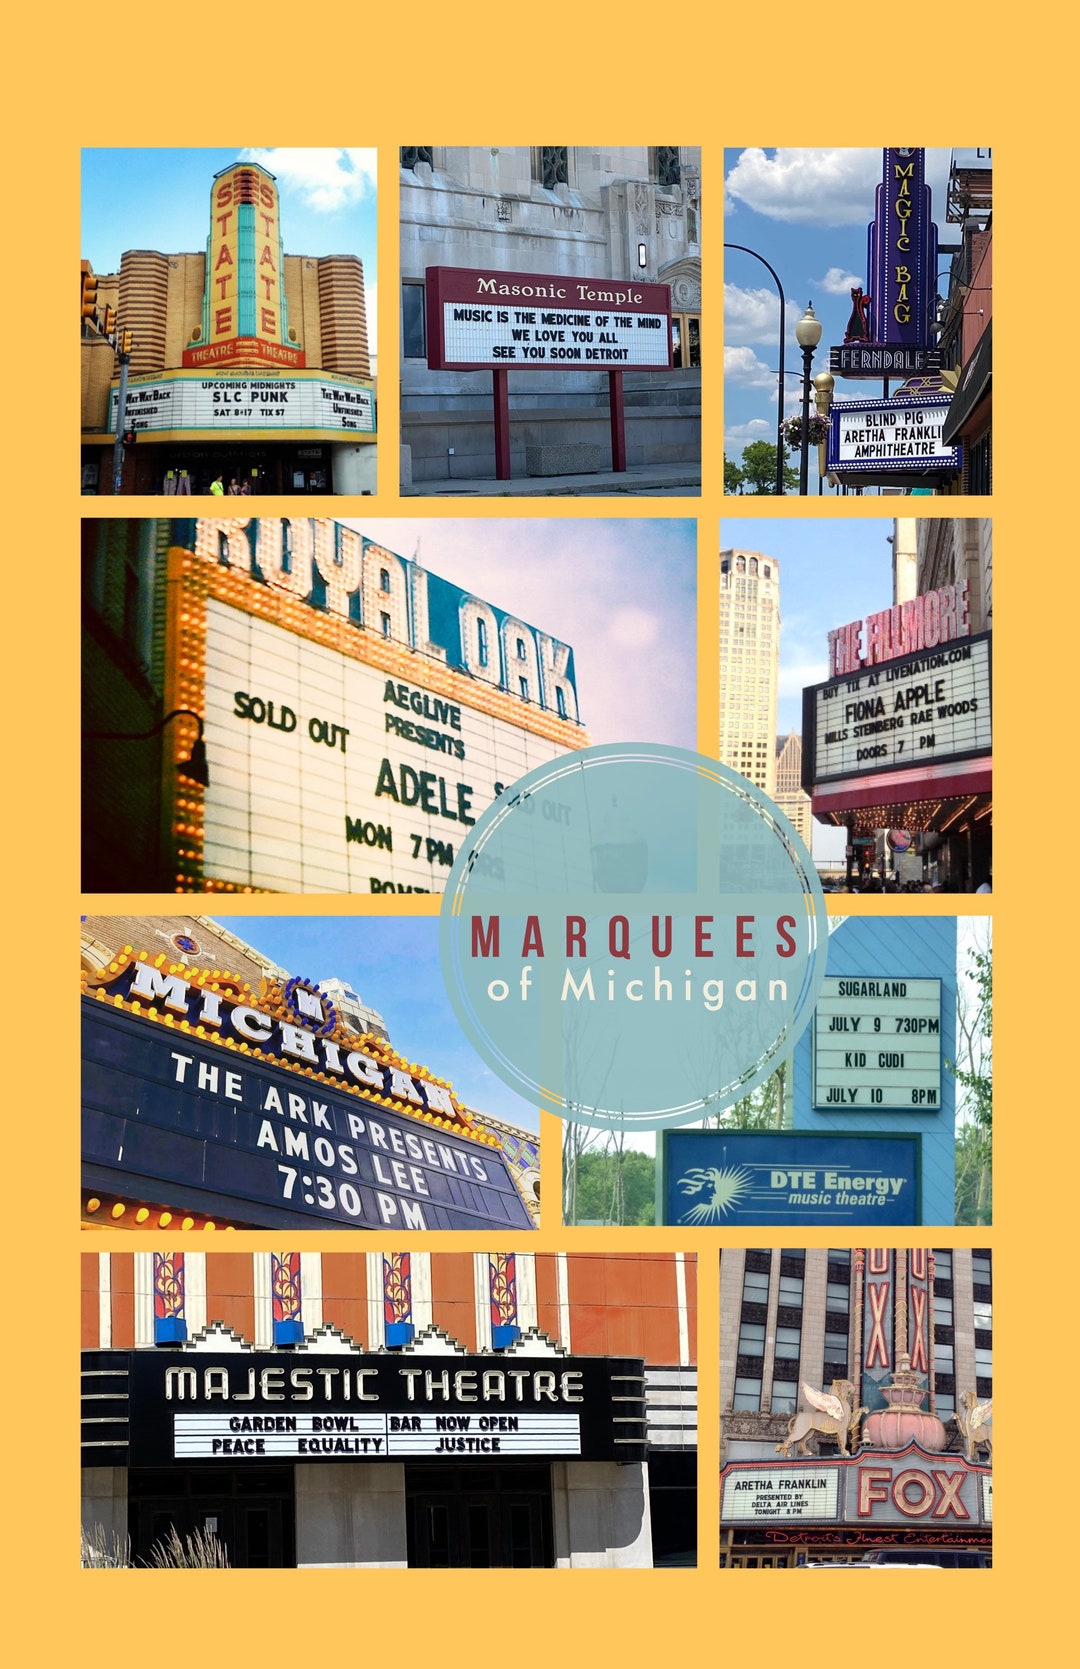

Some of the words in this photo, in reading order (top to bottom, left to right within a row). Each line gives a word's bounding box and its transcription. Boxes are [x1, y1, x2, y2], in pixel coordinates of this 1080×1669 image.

[893, 162, 914, 251] MAGIC
[215, 182, 233, 335] STATE
[259, 183, 277, 336] STATE
[477, 278, 566, 299] Masonic
[576, 285, 643, 305] Temple
[893, 266, 912, 324] BAG
[453, 308, 492, 323] MUSIC
[497, 311, 509, 323] IS
[515, 312, 536, 325] THE
[541, 313, 591, 327] MEDICINE
[595, 315, 609, 327] OF
[614, 316, 633, 328] THE
[637, 317, 661, 329] MIND
[512, 329, 530, 341] WE
[535, 330, 565, 342] LOVE
[572, 330, 594, 343] YOU
[599, 331, 618, 344] ALL
[192, 344, 234, 362] THEATRE
[261, 343, 298, 364] THEATRE
[492, 346, 516, 358] SEE
[522, 346, 546, 359] YOU
[550, 347, 581, 360] SOON
[585, 348, 629, 360] DETROIT
[841, 349, 925, 370] FERNDALE
[251, 391, 288, 403] PUNK
[866, 413, 897, 426] BLIND
[904, 411, 924, 425] PIG
[844, 429, 886, 444] ARETHA
[894, 425, 941, 440] FRANKLI
[854, 441, 936, 458] AMPHITHEATRE
[828, 620, 863, 679] THE
[865, 578, 971, 667] FILLMORE
[458, 594, 581, 722] OAK
[823, 686, 840, 700] BUY
[847, 680, 860, 693] TIX
[868, 675, 881, 688] AT
[886, 646, 971, 682] LIVENATION.COM
[846, 696, 885, 724] FIONA
[894, 679, 945, 713] APPLE
[234, 691, 297, 733] SOLD
[308, 716, 350, 753] OUT
[825, 728, 848, 744] MILLS
[853, 716, 904, 738] STEINBERG
[910, 709, 933, 725] RAE
[937, 698, 978, 718] WOODS
[385, 712, 465, 760] PRESENTS
[857, 744, 888, 761] DOORS
[898, 741, 904, 753] 7
[920, 734, 935, 749] PM
[375, 758, 476, 826] ADELE
[345, 815, 393, 853] MON
[838, 981, 907, 997] SUGARLAND
[296, 987, 324, 1023] M
[829, 1017, 861, 1032] JULY
[874, 1017, 881, 1032] 9
[895, 1018, 940, 1033] 730PM
[130, 960, 458, 1119] MICHIGAN
[845, 1053, 866, 1067] KID
[878, 1053, 904, 1068] CUDI
[826, 1088, 858, 1103] JULY
[871, 1088, 883, 1103] 10
[911, 1089, 937, 1104] 8PM
[171, 1053, 243, 1102] THE
[264, 1086, 332, 1131] ARK
[347, 1114, 489, 1182] PRESENTS
[257, 1120, 358, 1175] AMOS
[372, 1155, 430, 1196] LEE
[770, 1171, 816, 1189] DTE
[824, 1172, 904, 1195] Energy
[278, 1165, 362, 1217] 7:30
[372, 1194, 427, 1230] PM
[788, 1191, 832, 1205] music
[835, 1193, 886, 1206] theatre
[165, 1367, 379, 1400] MAJESTIC
[398, 1369, 584, 1401] THEATRE
[229, 1416, 297, 1432] GARDEN
[312, 1416, 359, 1432] BOWL
[390, 1416, 422, 1432] BAR
[435, 1416, 471, 1432] NOW
[479, 1416, 519, 1432] OPEN
[212, 1438, 266, 1455] PEACE
[298, 1438, 383, 1454] EQUALITY
[435, 1437, 501, 1453] JUSTICE
[735, 1481, 773, 1490] ARETHA
[778, 1479, 827, 1489] FRANKLIN
[857, 1466, 970, 1519] FOX
[765, 1531, 842, 1544] Detroit's
